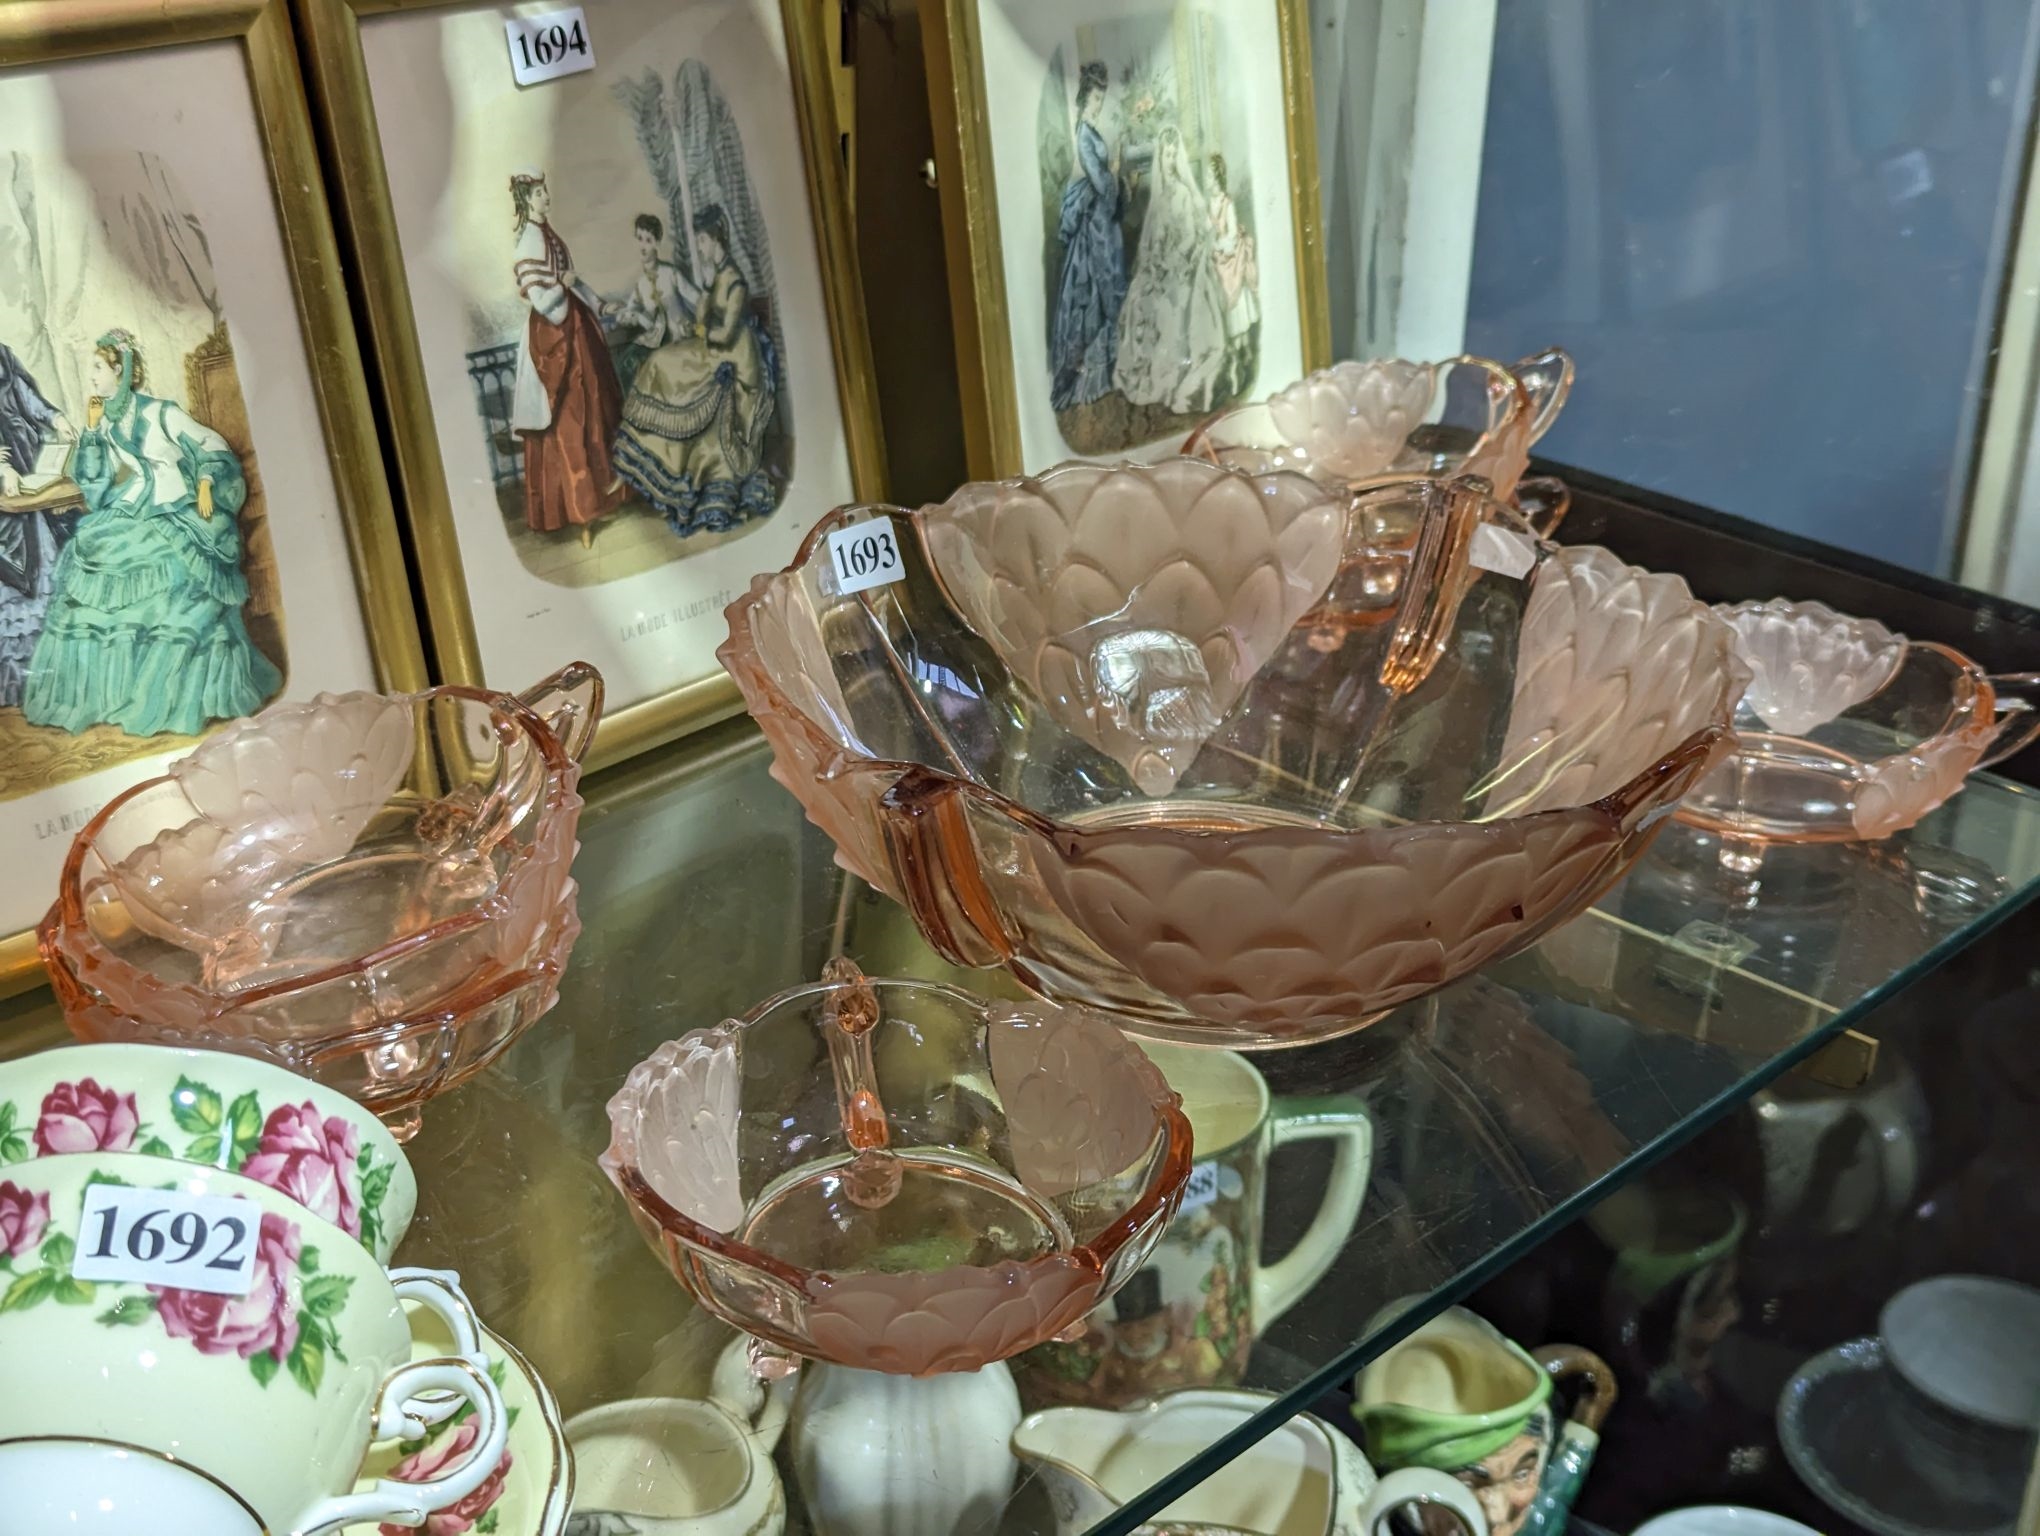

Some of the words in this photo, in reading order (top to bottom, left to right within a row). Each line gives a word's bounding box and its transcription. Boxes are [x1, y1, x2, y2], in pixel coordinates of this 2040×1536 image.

[517, 19, 587, 70] 1694
[835, 533, 896, 580] 1693
[620, 625, 637, 642] LA
[637, 613, 668, 636] MODE
[34, 819, 58, 840] LA
[86, 1205, 246, 1272] 1692
